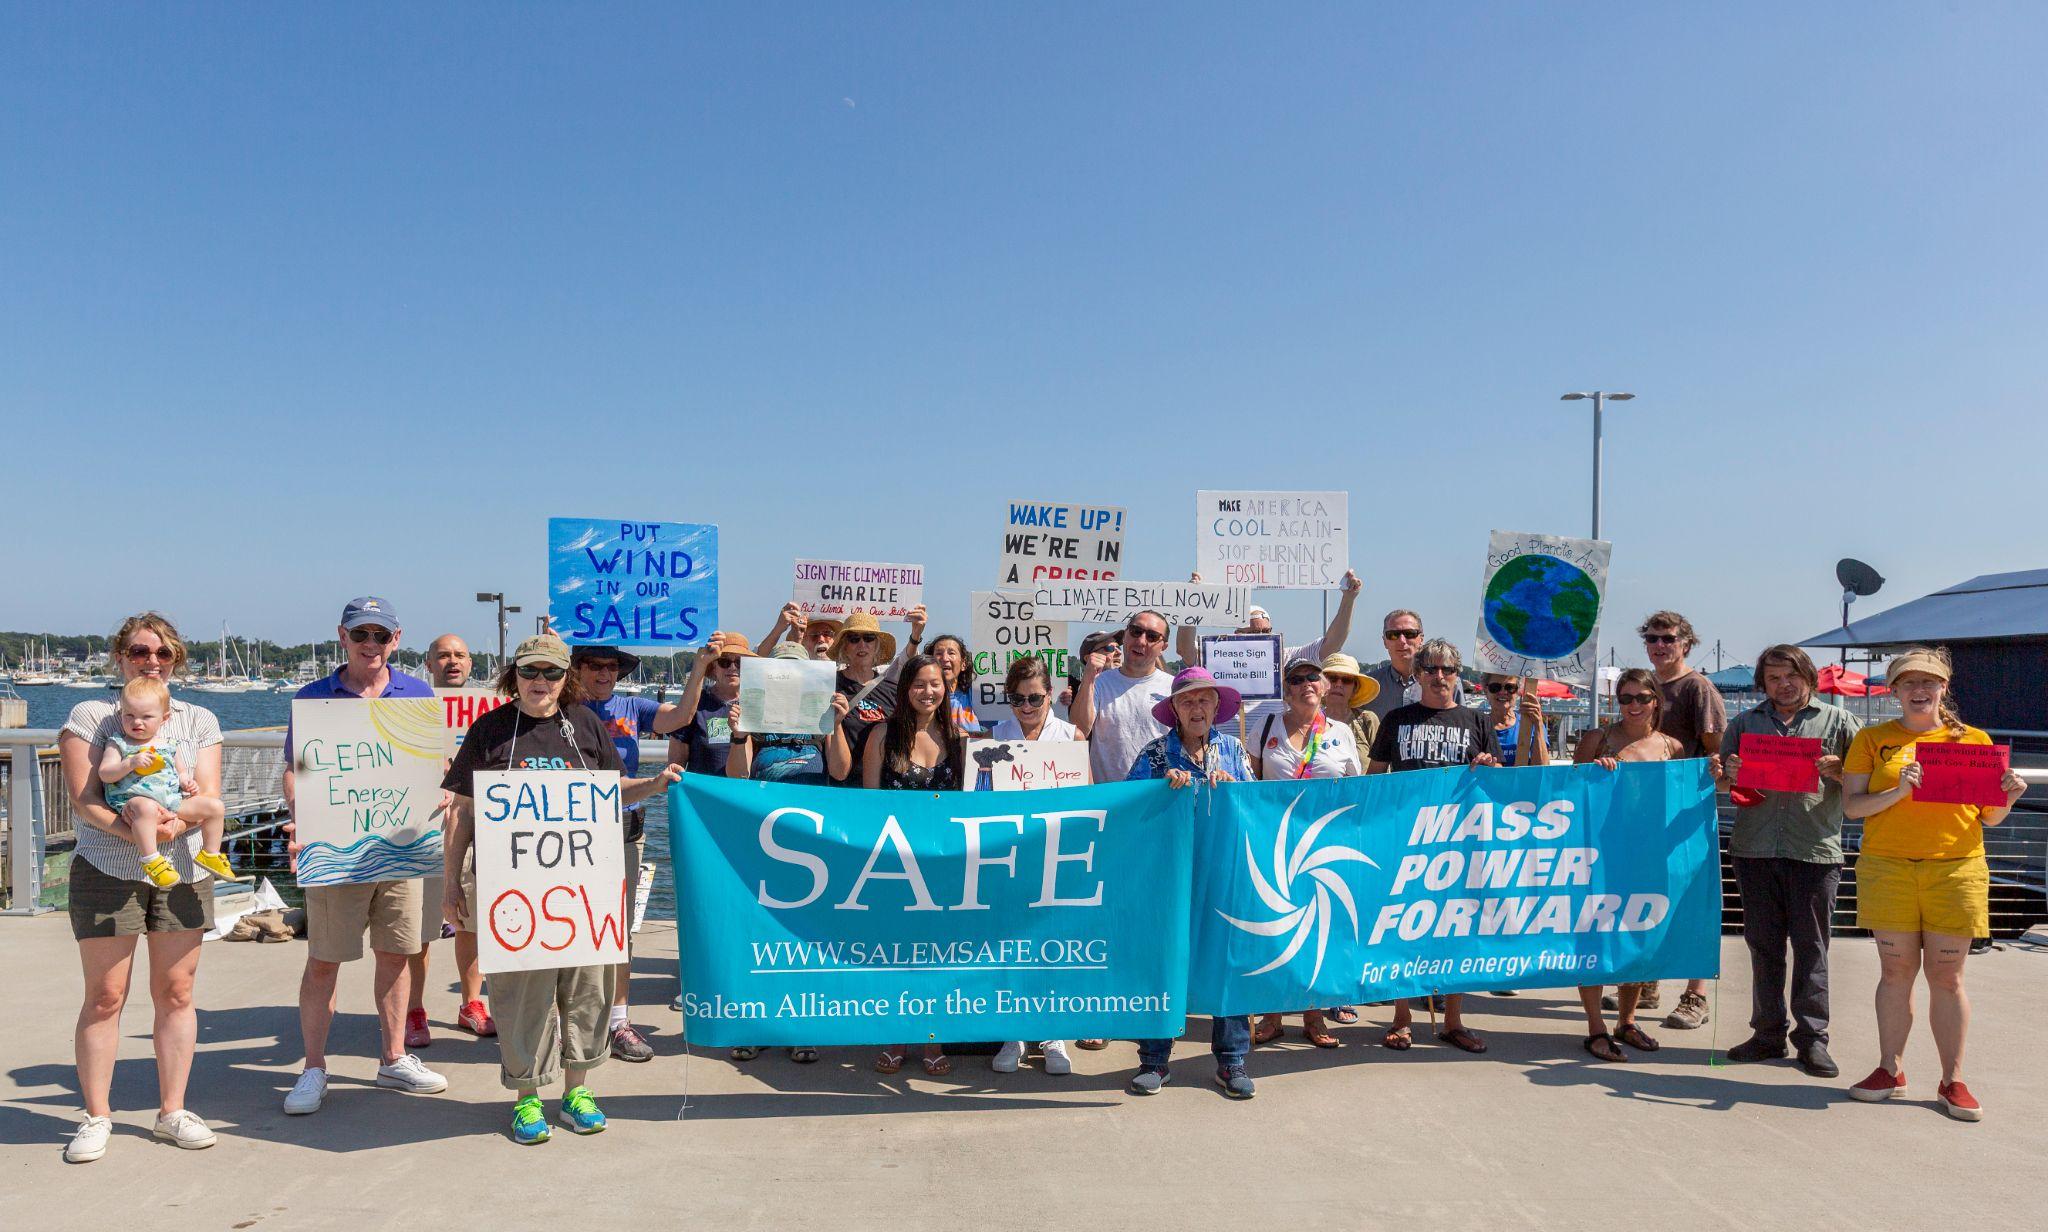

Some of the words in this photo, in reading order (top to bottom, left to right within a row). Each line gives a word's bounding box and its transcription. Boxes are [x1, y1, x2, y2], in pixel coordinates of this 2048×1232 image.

[1010, 503, 1067, 529] WAKE
[1080, 509, 1122, 531] UP!
[1218, 499, 1241, 512] MAKE
[1246, 498, 1328, 516] AMERICA
[621, 523, 661, 542] PUT
[1213, 518, 1271, 536] COOL
[1005, 533, 1080, 559] WE'RE
[1097, 540, 1120, 562] IN
[1217, 544, 1250, 561] STOP
[1259, 543, 1333, 563] BURNING
[1488, 542, 1522, 568] Good
[1575, 549, 1599, 576] Are
[585, 547, 693, 578] WIND
[796, 564, 827, 581] SIGN
[830, 565, 851, 582] THE
[854, 566, 899, 584] CLIMATE
[900, 568, 922, 586] BILL
[1007, 563, 1019, 583] A
[1032, 565, 1116, 582] CRISIS
[1226, 562, 1269, 585] FOSSIL
[595, 579, 620, 596] IN
[636, 581, 670, 597] OUR
[821, 584, 898, 603] CHARLIE
[1035, 587, 1118, 607] CLIMATE
[1125, 587, 1173, 607] BILL
[1176, 588, 1220, 609] NOW
[572, 602, 699, 641] SAILS
[988, 601, 1034, 621] SIG
[1082, 608, 1119, 623] THE
[1184, 615, 1203, 626] ON
[995, 625, 1052, 645] OUR
[1213, 649, 1244, 658] Please
[1246, 648, 1266, 659] Sign
[1233, 660, 1247, 669] the
[1480, 639, 1513, 672] Hard
[1517, 654, 1537, 678] To
[1213, 671, 1247, 680] Climate
[1250, 670, 1267, 679] Bill!
[1397, 724, 1411, 743] NO
[1412, 724, 1445, 743] MUSIC
[1446, 725, 1461, 744] ON
[1461, 728, 1471, 746] A
[302, 738, 394, 771] CLEAN
[524, 756, 565, 769] 350
[1399, 739, 1425, 761] DEAD
[1427, 741, 1469, 764] PLANET
[1011, 763, 1033, 781] No
[1043, 760, 1082, 780] More
[328, 775, 410, 815] Energy
[484, 782, 620, 824] SALEM
[353, 806, 410, 833] NOW
[1406, 799, 1575, 847] MASS
[511, 828, 595, 870] FOR
[758, 806, 1108, 912] SAFE
[1389, 847, 1599, 896] POWER
[489, 878, 628, 952] OSW
[1367, 893, 1671, 946] FORWARD
[751, 938, 1108, 967] WWW.SALEMSAFE.ORG
[1360, 961, 1387, 985] For
[1390, 965, 1400, 980] a
[1404, 955, 1454, 979] clean
[1460, 952, 1532, 977] energy
[1538, 950, 1598, 972] future
[684, 992, 768, 1019] Salem
[775, 991, 889, 1019] Alliance
[897, 989, 937, 1016] for
[946, 988, 987, 1015] the
[995, 988, 1171, 1014] Environment
